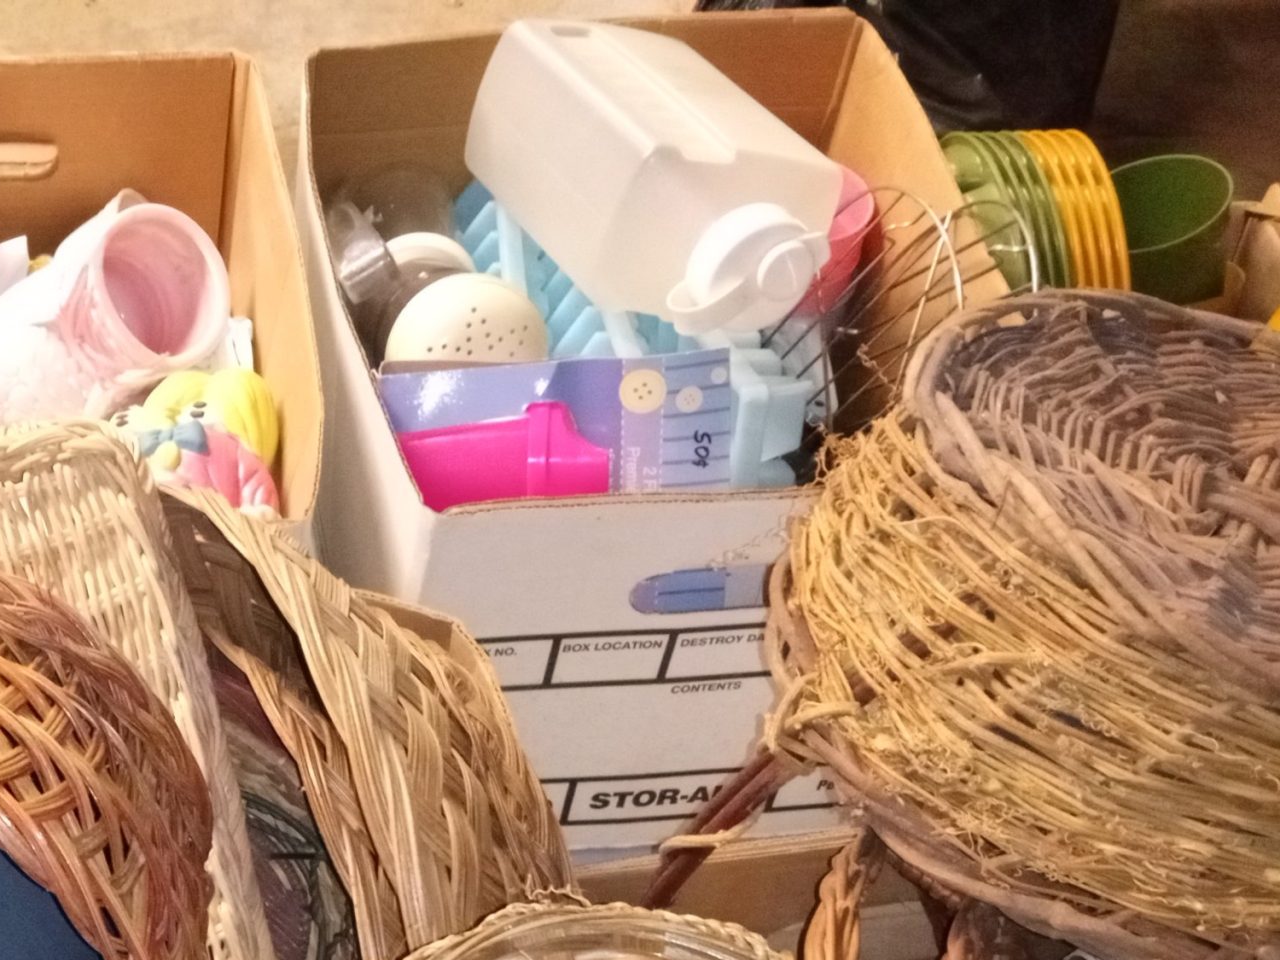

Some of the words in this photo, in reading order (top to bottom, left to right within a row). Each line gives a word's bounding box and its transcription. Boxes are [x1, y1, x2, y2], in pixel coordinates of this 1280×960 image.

[562, 642, 590, 653] BOX
[594, 639, 663, 650] LOCATION
[680, 635, 743, 648] DESTROY
[671, 680, 742, 695] CONTENTS
